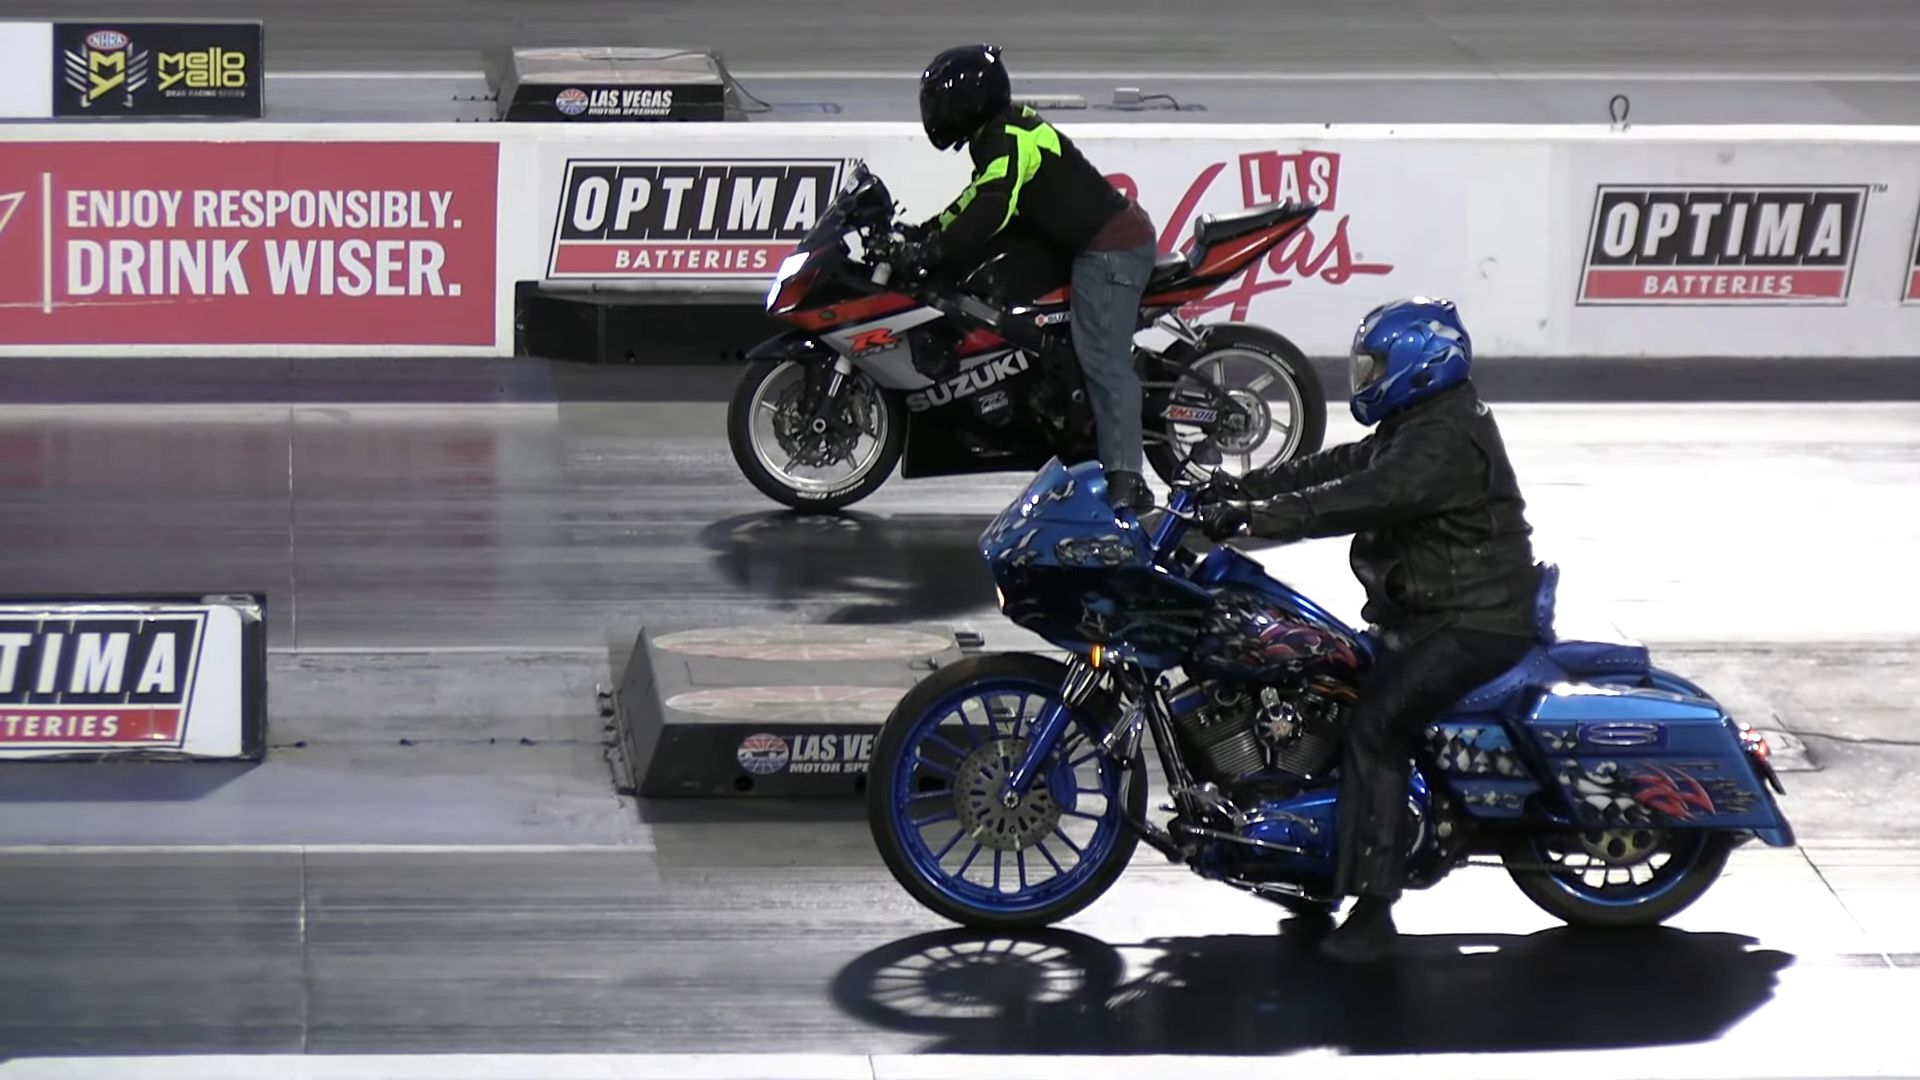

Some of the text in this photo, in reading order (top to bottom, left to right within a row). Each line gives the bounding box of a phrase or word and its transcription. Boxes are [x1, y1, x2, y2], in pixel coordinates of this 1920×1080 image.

[91, 33, 125, 47] NHRA
[590, 89, 673, 108] LAS VEGAS
[622, 108, 671, 116] SPEEDWAY
[1250, 156, 1332, 206] LAS
[67, 190, 463, 229] ENJOY RESPONSIBLY.
[572, 176, 818, 232] OPTIMA
[1602, 202, 1843, 258] OPTIMA
[67, 239, 463, 297] DRINK WISER.
[615, 249, 767, 270] BATTERIES
[1643, 275, 1793, 295] BATTERIES
[905, 350, 1029, 412] SUZUKI
[0, 632, 176, 694] TIMA
[0, 715, 119, 737] TERIES
[791, 734, 838, 761] LAS
[789, 762, 841, 773] MOTOR
